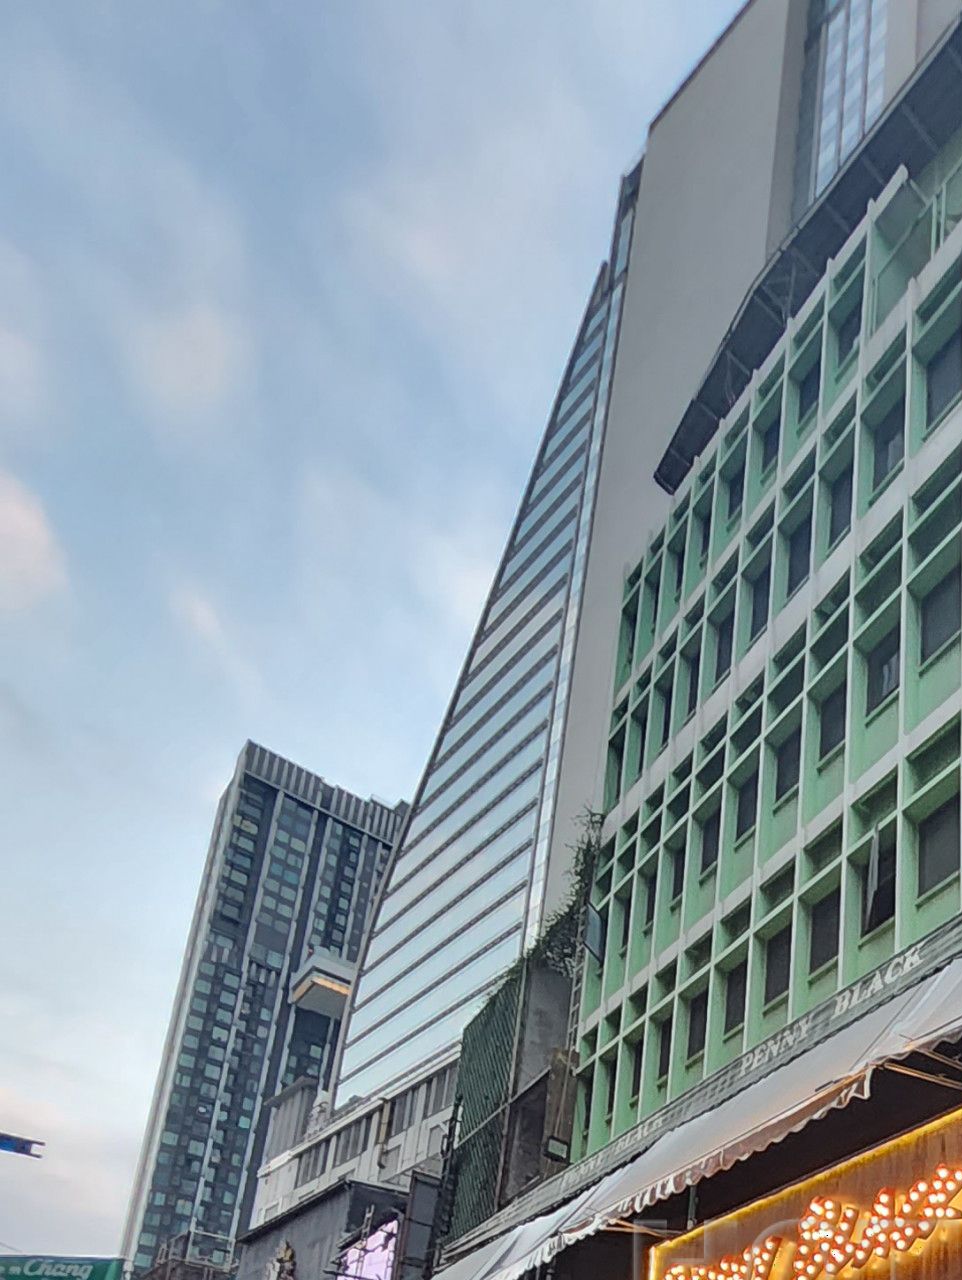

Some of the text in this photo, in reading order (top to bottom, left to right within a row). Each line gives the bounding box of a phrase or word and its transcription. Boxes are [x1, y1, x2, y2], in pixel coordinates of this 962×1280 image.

[738, 942, 924, 1078] PENNY BLACK
[22, 1258, 94, 1280] Chang
